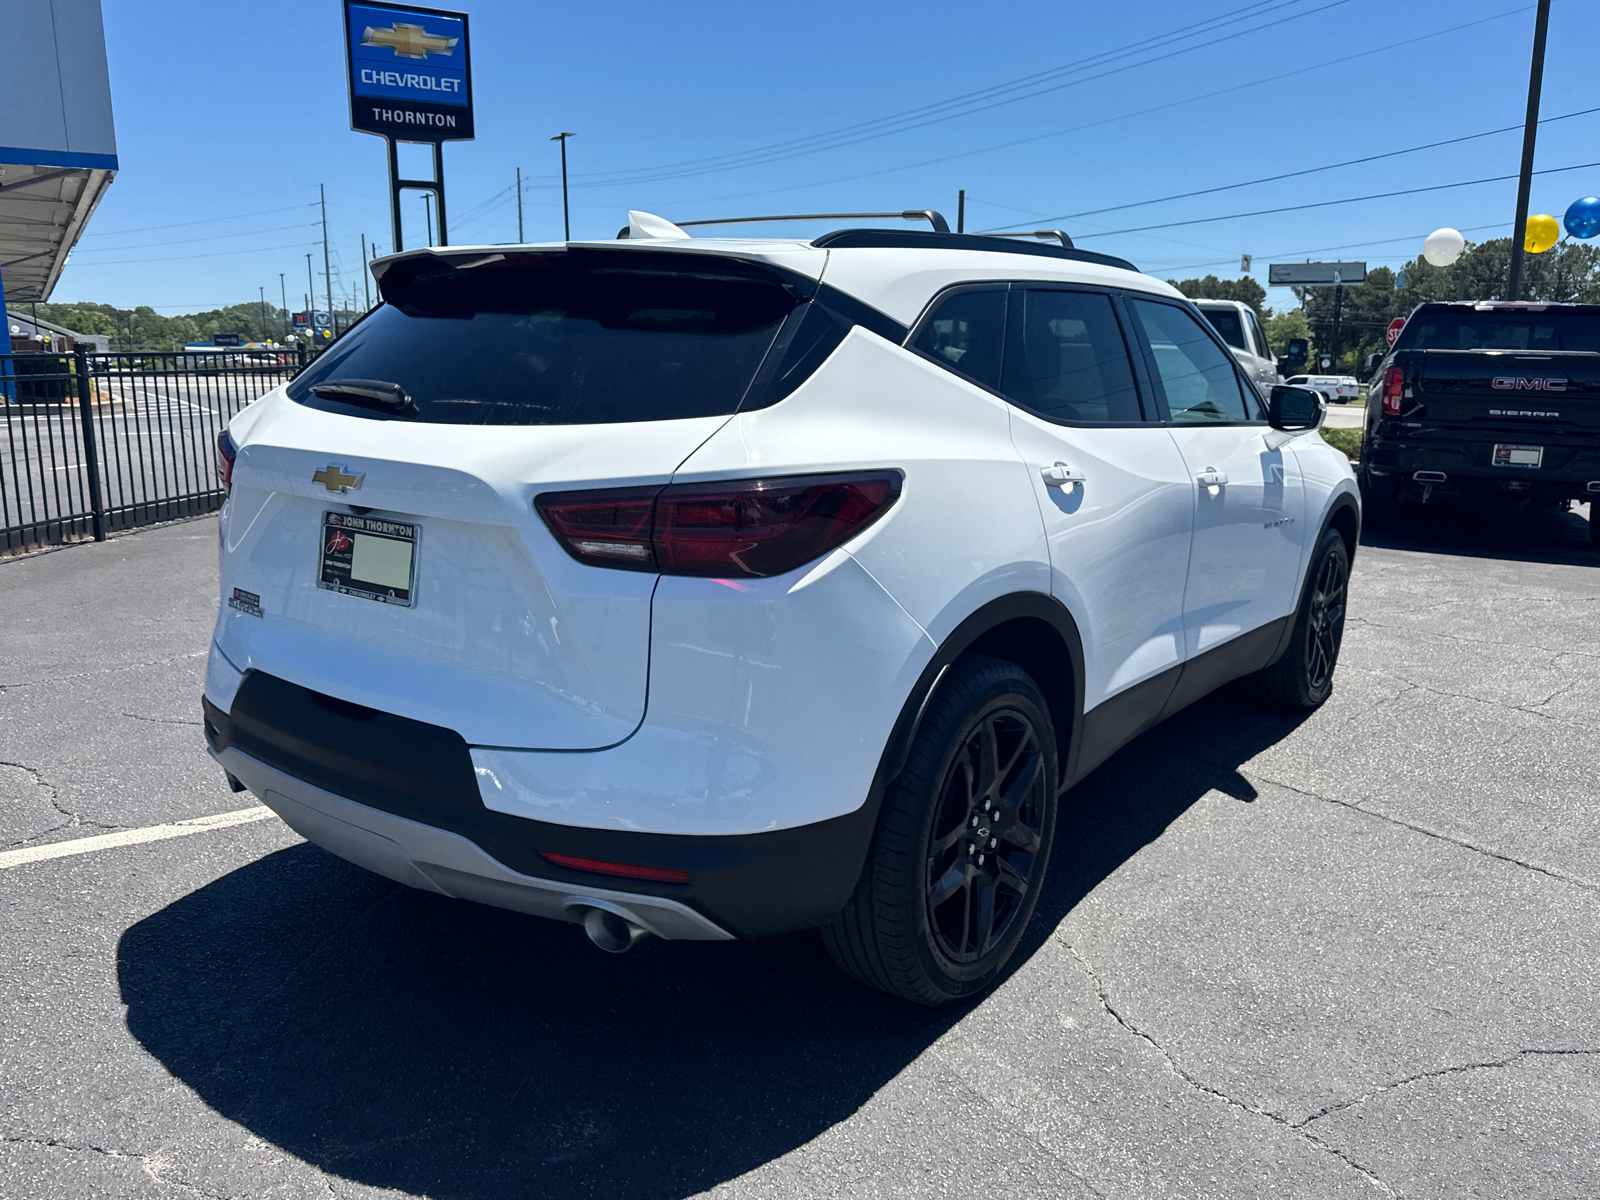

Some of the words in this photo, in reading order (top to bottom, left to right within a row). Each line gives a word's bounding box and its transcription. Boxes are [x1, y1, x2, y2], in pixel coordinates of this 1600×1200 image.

[361, 69, 461, 92] CHEVROLET
[372, 108, 456, 127] THORNTON
[1492, 376, 1567, 391] GMC
[1489, 409, 1559, 417] SIERRA
[343, 516, 365, 528] JOHN
[366, 520, 413, 537] THORNTON
